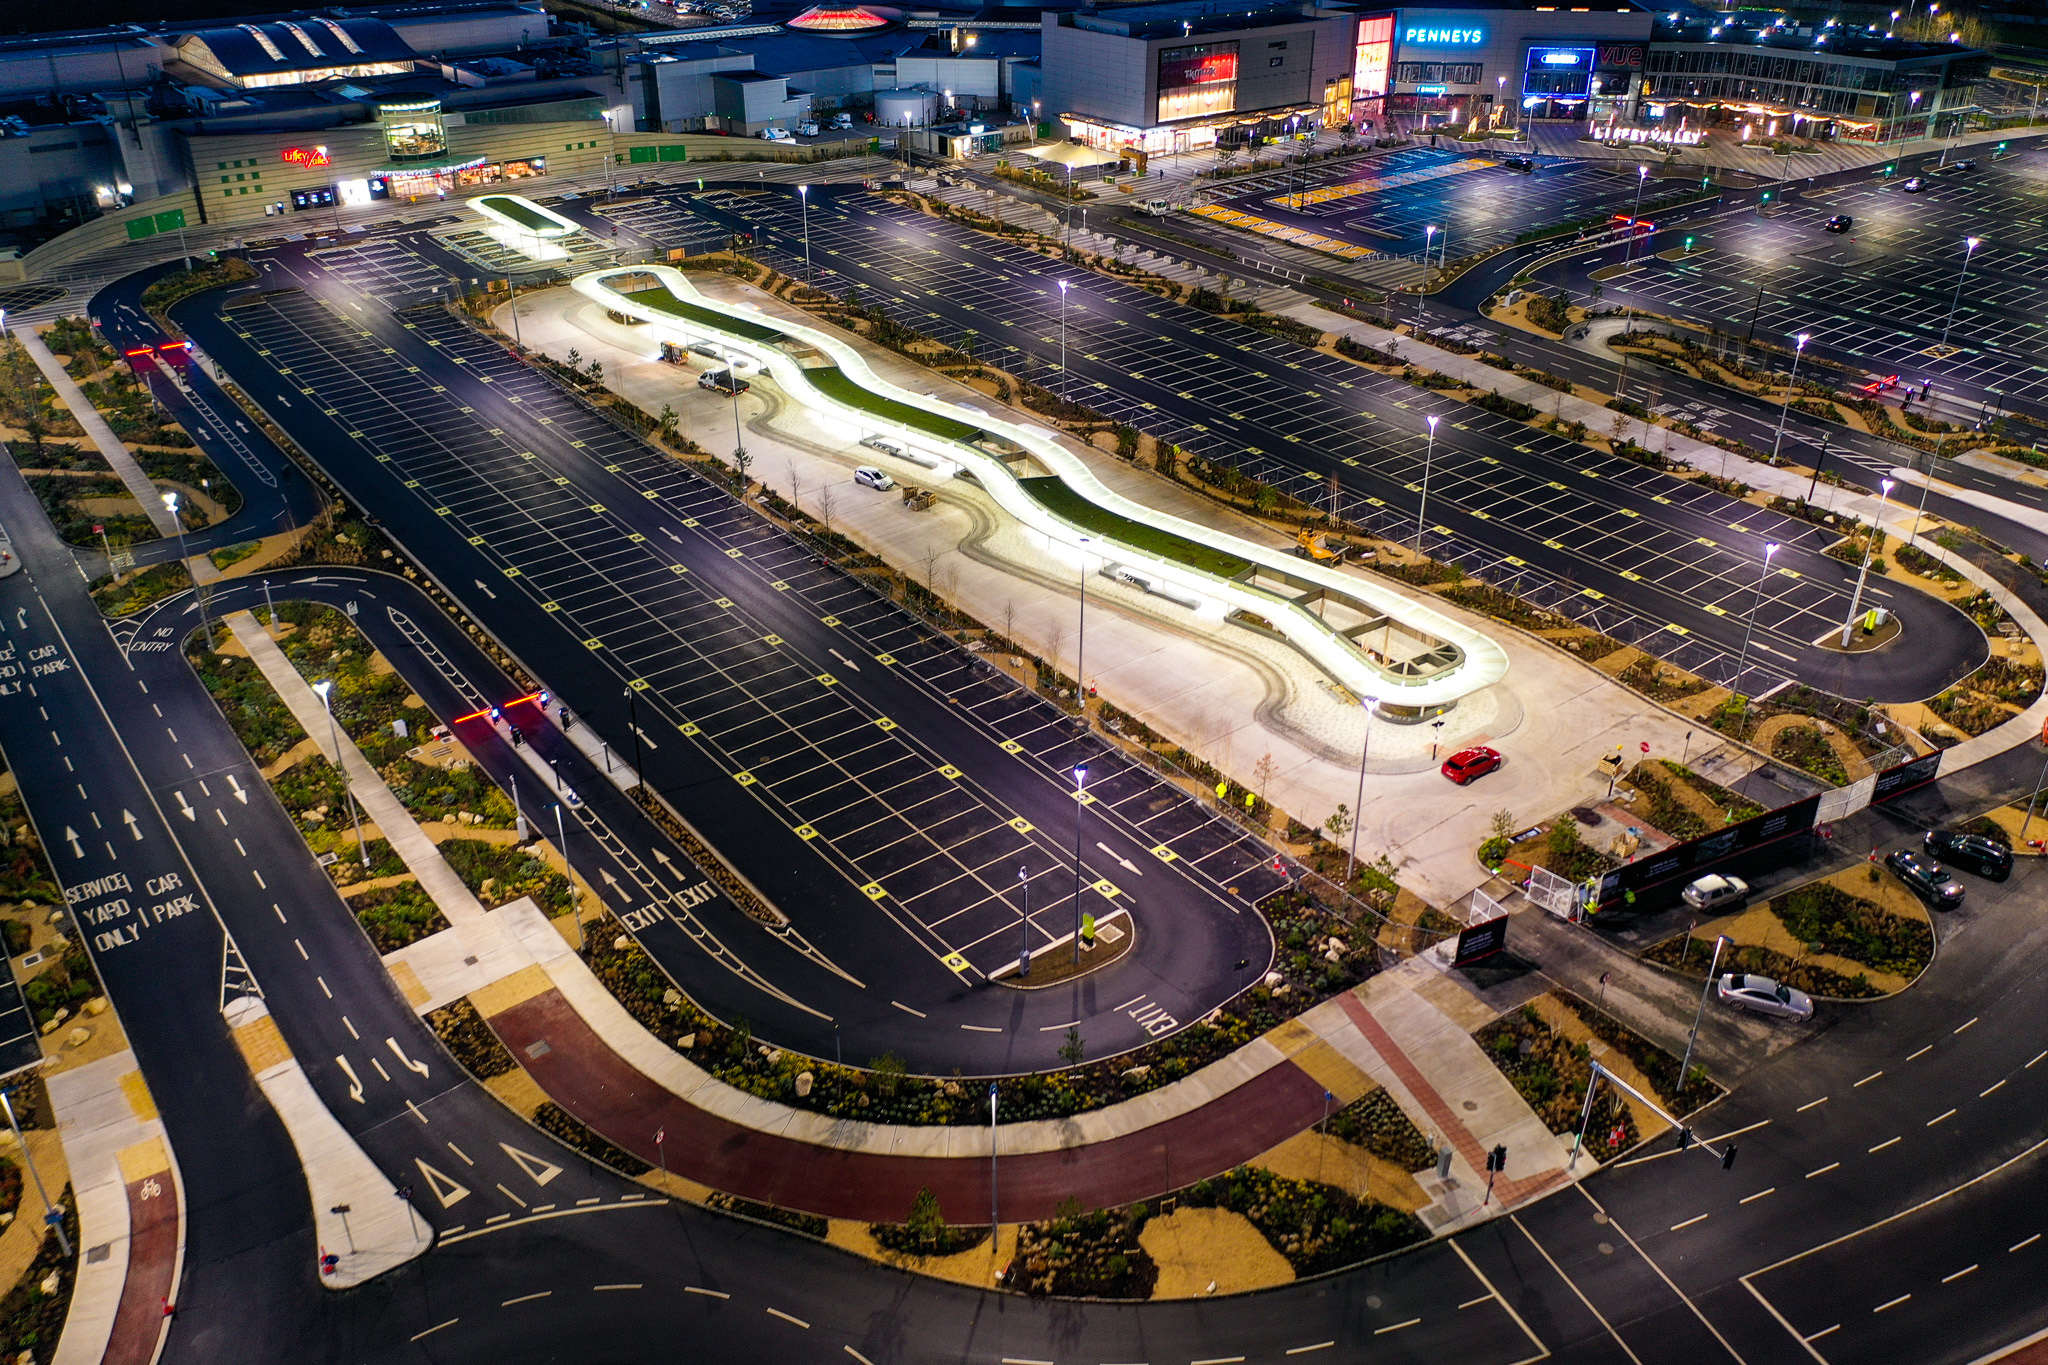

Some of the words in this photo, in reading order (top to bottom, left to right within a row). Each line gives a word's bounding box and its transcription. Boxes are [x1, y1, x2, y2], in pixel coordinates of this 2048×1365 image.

[1406, 28, 1482, 43] PENNEYS
[1594, 127, 1649, 143] LIFFEY
[153, 627, 174, 638] NO
[29, 644, 58, 661] CAR
[130, 641, 174, 652] ENTRY
[32, 657, 71, 678] PARK
[65, 871, 129, 905] SERVICE
[146, 872, 183, 897] CAR
[674, 880, 718, 909] EXIT
[82, 898, 131, 926] YARD
[152, 892, 200, 923] PARK
[621, 902, 665, 932] EXIT
[94, 922, 140, 952] ONLY
[1128, 1001, 1179, 1036] EXIT
